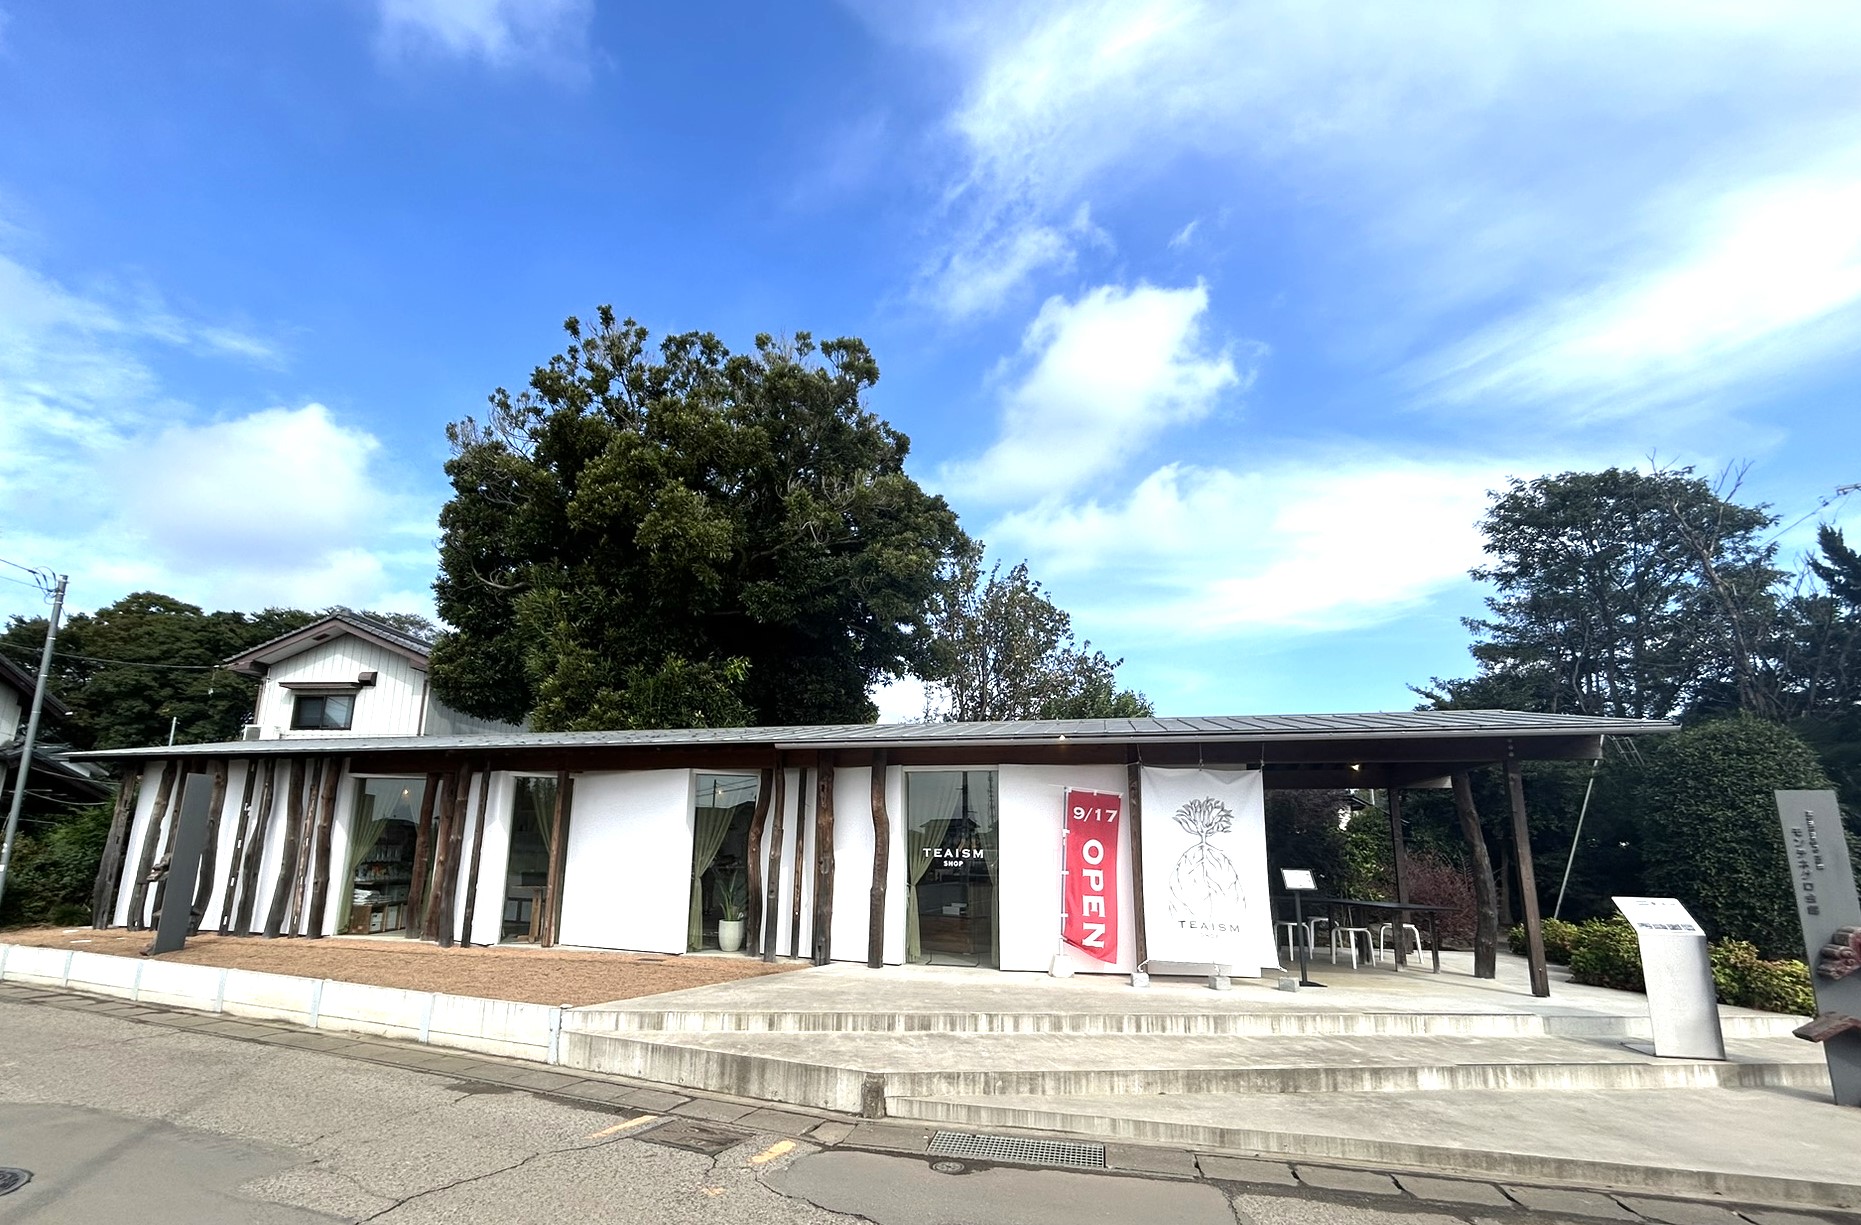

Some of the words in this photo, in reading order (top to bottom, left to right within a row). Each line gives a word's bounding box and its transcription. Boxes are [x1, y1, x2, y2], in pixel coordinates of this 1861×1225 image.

[1073, 806, 1118, 823] 9/17
[922, 847, 984, 859] TEAISM
[1081, 838, 1106, 949] OPEN
[1178, 920, 1240, 933] TEAISM
